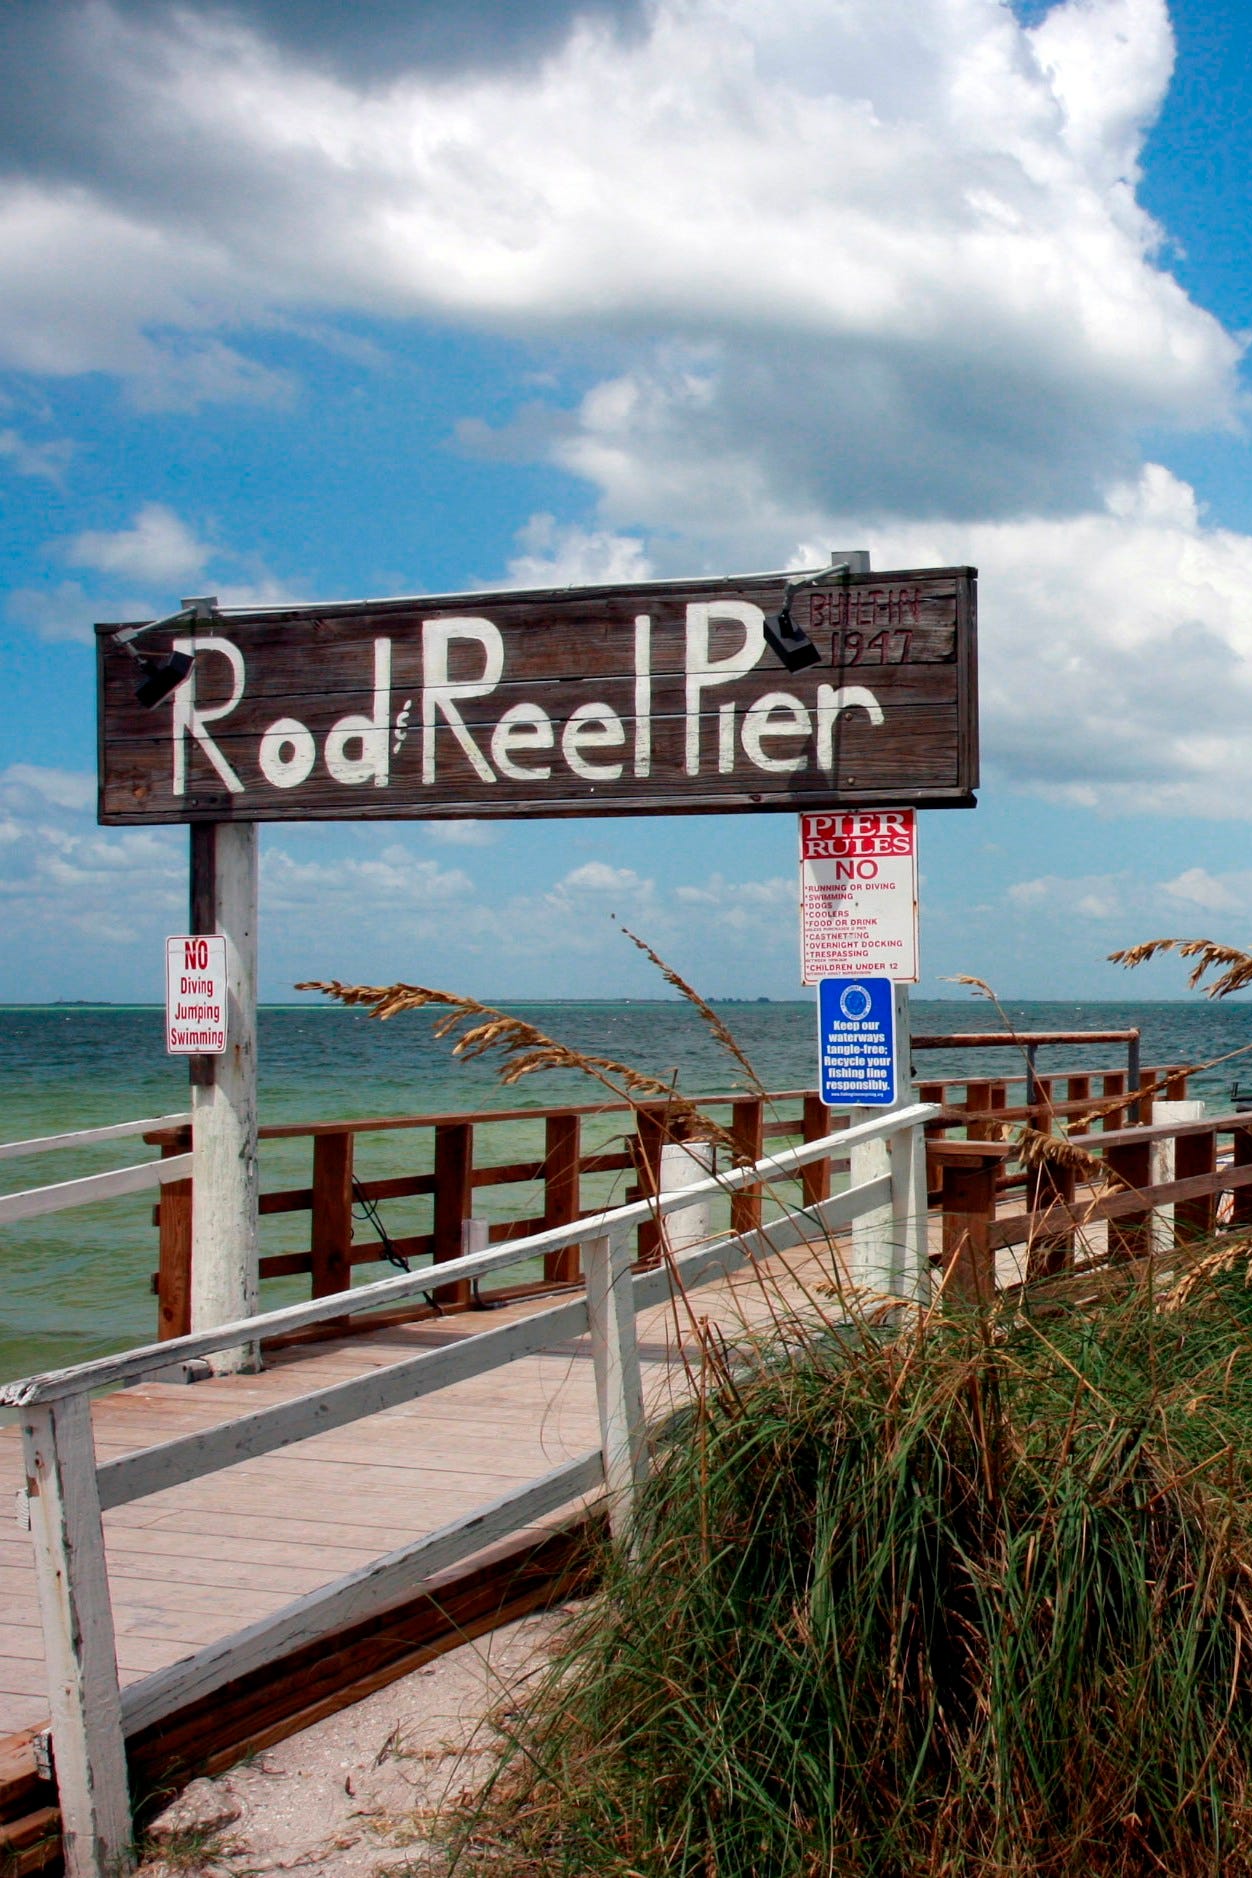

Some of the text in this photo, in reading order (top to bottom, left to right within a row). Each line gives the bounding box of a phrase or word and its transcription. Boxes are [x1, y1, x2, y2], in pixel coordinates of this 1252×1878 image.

[831, 629, 913, 667] 1947
[172, 637, 391, 796] Rod
[421, 614, 651, 785] Reel
[684, 599, 885, 777] Pier
[805, 813, 910, 839] PIER
[806, 836, 910, 857] RULES
[835, 859, 879, 881] NO
[808, 882, 896, 892] RUNNING OR DIVING
[808, 893, 853, 901] SWIMMING
[809, 910, 849, 918] COOLERS
[850, 918, 877, 926] DRINK
[809, 932, 869, 941] CASTNETTING
[810, 940, 903, 949] OVERNIGHT DOCKING
[184, 940, 208, 970] NO
[810, 950, 869, 958] TRESPASSING
[810, 962, 898, 972] CHILDREN UNDER 12
[180, 976, 213, 998] Diving
[175, 1002, 220, 1024] Jumping
[833, 1020, 880, 1031] Keep our
[171, 1027, 223, 1048] Swimming
[828, 1033, 885, 1043] waterways
[824, 1056, 891, 1066] Recycle your
[828, 1068, 887, 1079] fishing line
[826, 1080, 890, 1091] responsibly.
